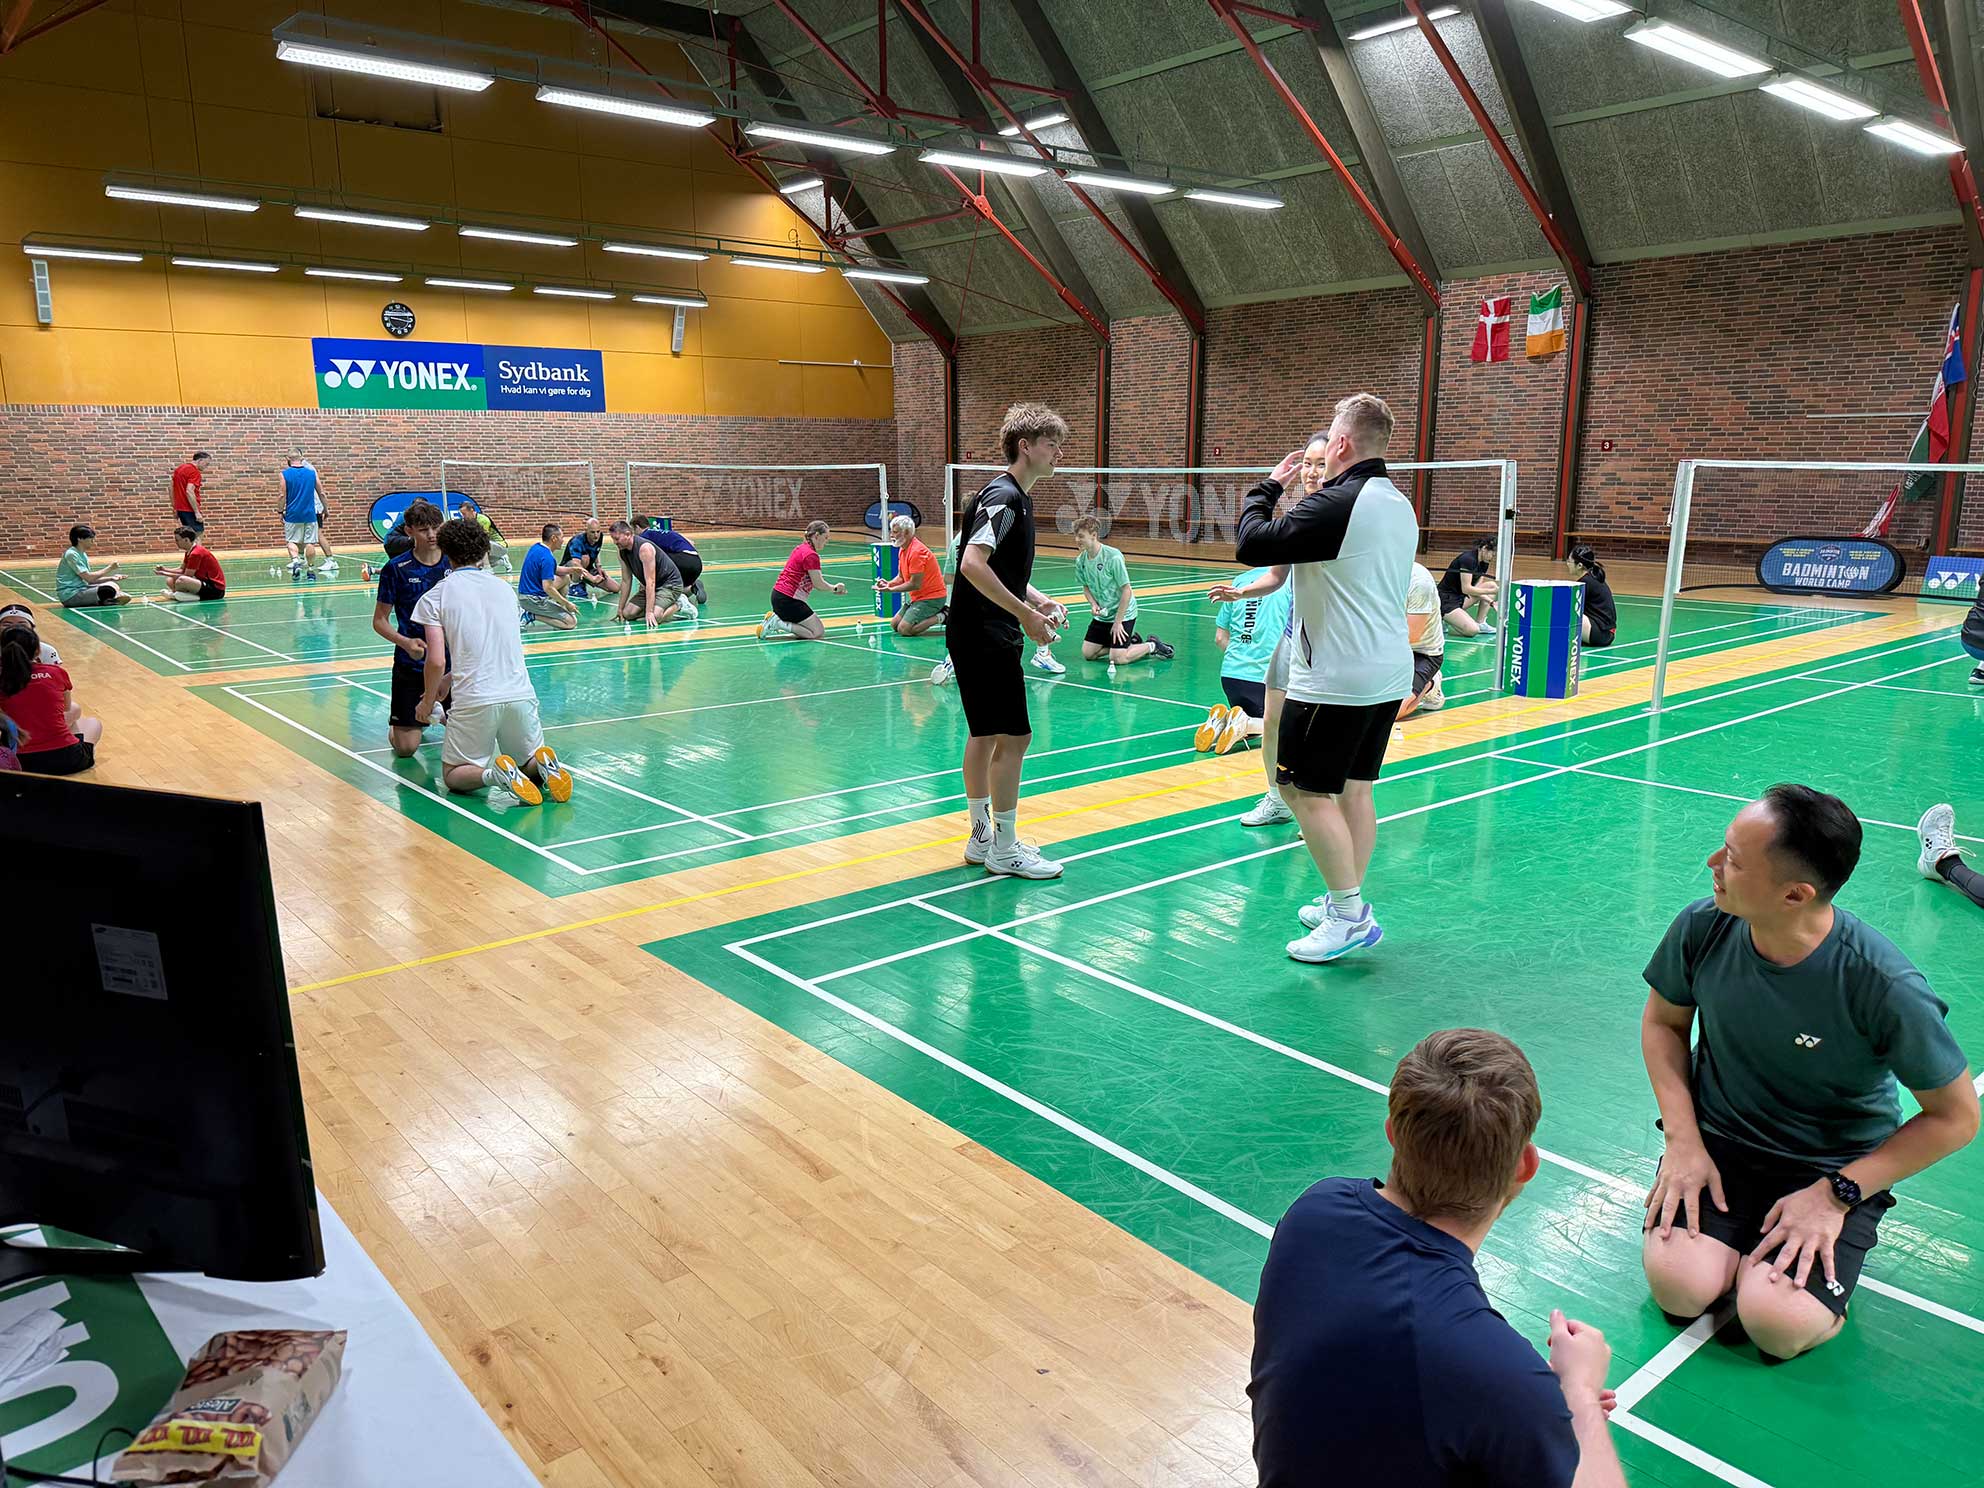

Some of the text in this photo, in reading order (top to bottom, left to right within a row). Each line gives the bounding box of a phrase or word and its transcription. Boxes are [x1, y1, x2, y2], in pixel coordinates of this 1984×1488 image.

[498, 360, 590, 384] Sydbank
[500, 385, 591, 398] Hvad kan vi gøre for dig
[1603, 441, 1609, 449] 3
[1795, 576, 1851, 589] WORLD CAMP
[1241, 600, 1258, 641] BADMIN
[1510, 634, 1524, 686] YONEX
[1569, 634, 1579, 687] YONEX
[31, 672, 52, 680] ORA
